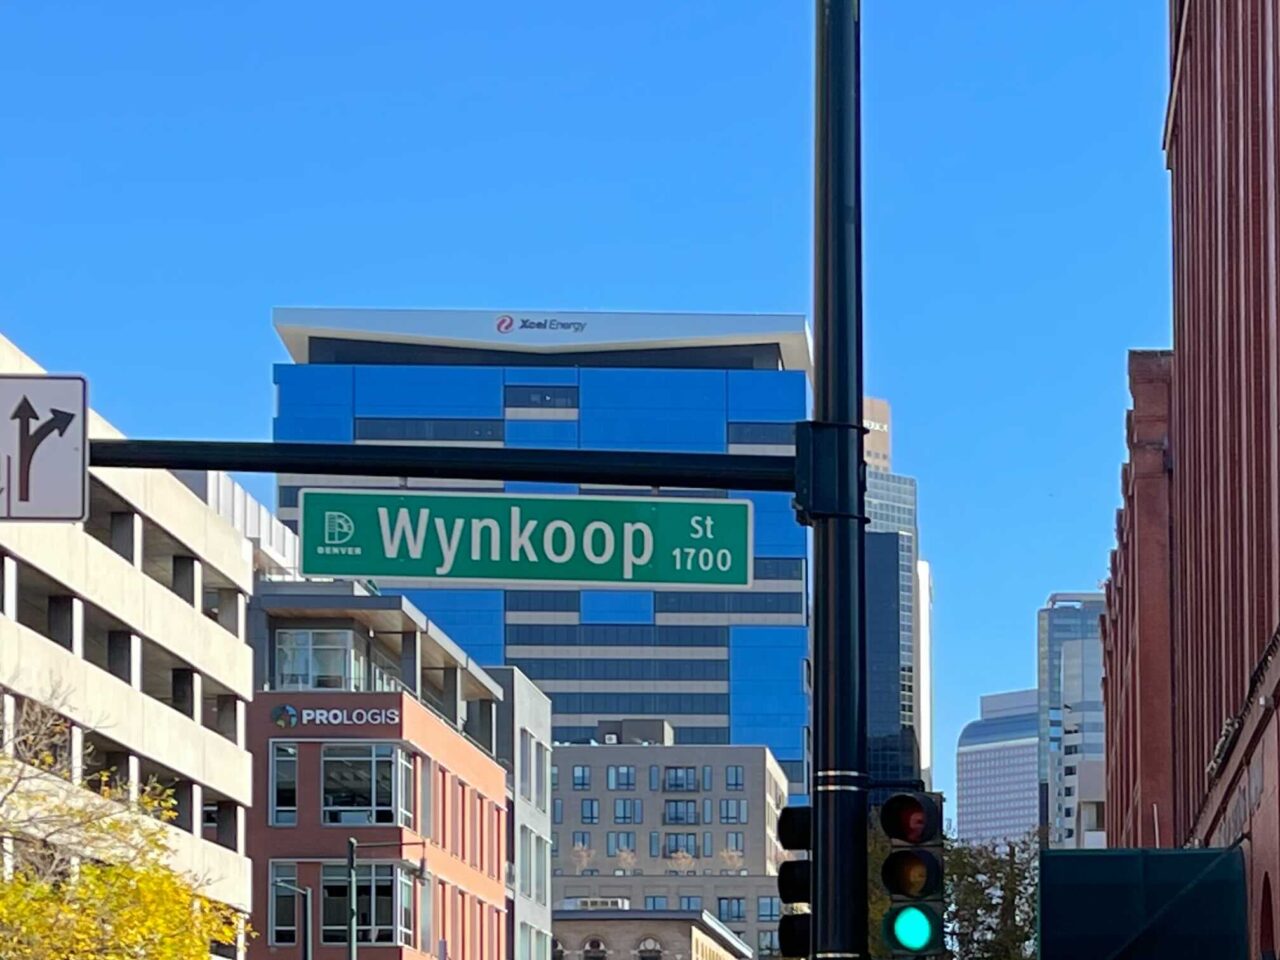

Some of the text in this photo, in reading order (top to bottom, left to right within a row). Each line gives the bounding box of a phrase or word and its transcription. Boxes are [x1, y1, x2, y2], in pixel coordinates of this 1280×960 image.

[519, 318, 587, 334] Xcel Energy
[690, 515, 714, 540] St
[316, 546, 362, 556] DENVER
[377, 505, 654, 579] Wynkoop
[671, 547, 732, 572] 1700
[301, 708, 400, 725] PROLOGIS
